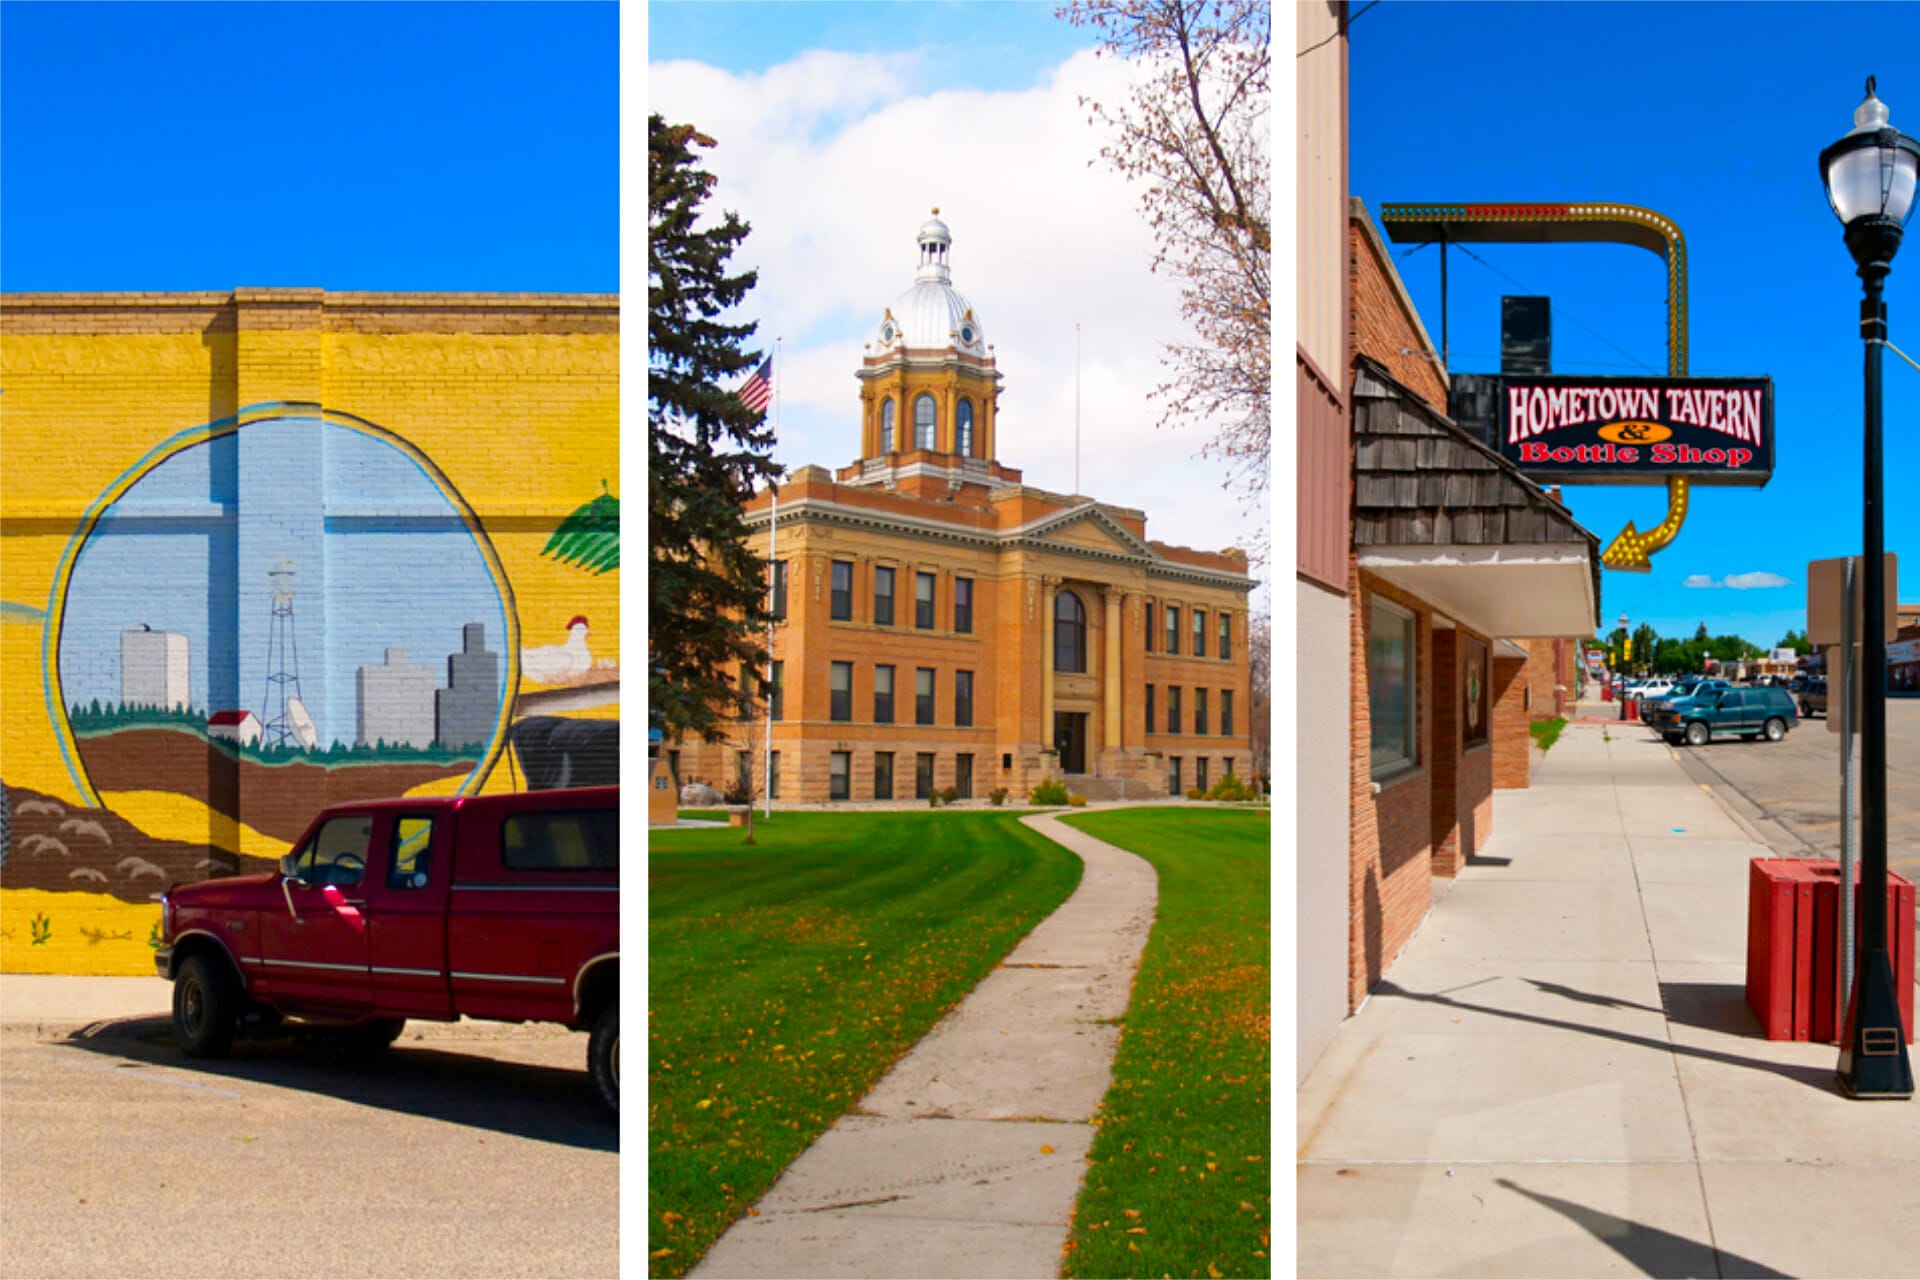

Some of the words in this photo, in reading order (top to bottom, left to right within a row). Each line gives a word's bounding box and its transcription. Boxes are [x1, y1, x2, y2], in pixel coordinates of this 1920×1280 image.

[1508, 386, 1660, 444] HOMETOWN
[1666, 388, 1762, 447] TAVERN
[1617, 424, 1651, 441] &
[1519, 442, 1640, 463] Bottle
[1650, 444, 1752, 467] Shop
